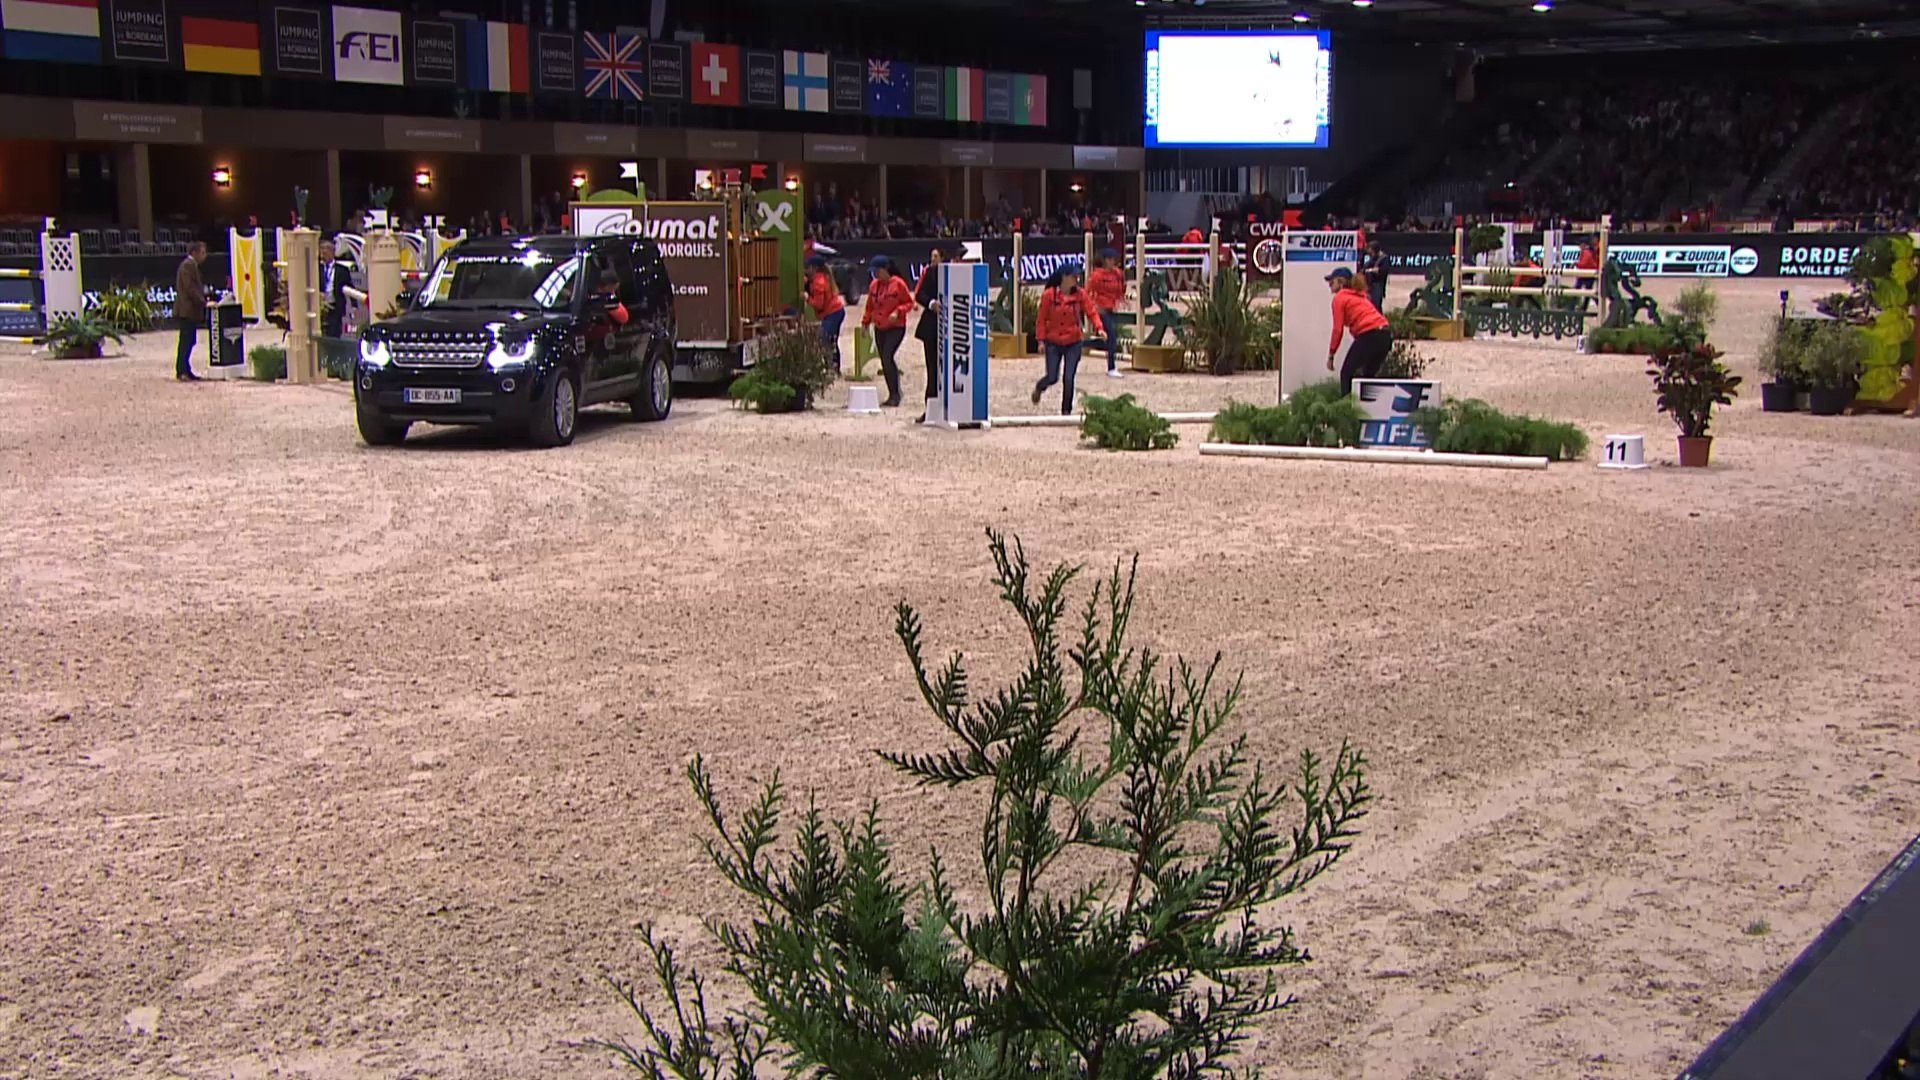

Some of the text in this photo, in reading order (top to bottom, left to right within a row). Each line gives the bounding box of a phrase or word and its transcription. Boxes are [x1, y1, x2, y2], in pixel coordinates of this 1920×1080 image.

[116, 10, 163, 25] JUMPING
[280, 26, 319, 39] JUMPING
[336, 32, 399, 62] FEI
[417, 38, 453, 51] JUMPING
[542, 50, 573, 61] JUMPING
[1322, 250, 1354, 261] LIFE
[1781, 247, 1860, 264] BORDEA
[1636, 263, 1656, 272] IFE
[1696, 263, 1726, 273] LIFE
[1780, 265, 1798, 275] MA
[1799, 265, 1831, 275] VILLE
[974, 293, 987, 340] LIFE
[953, 293, 970, 378] EQUIDIA
[1360, 423, 1427, 444] LIFE
[1604, 441, 1627, 461] 11
